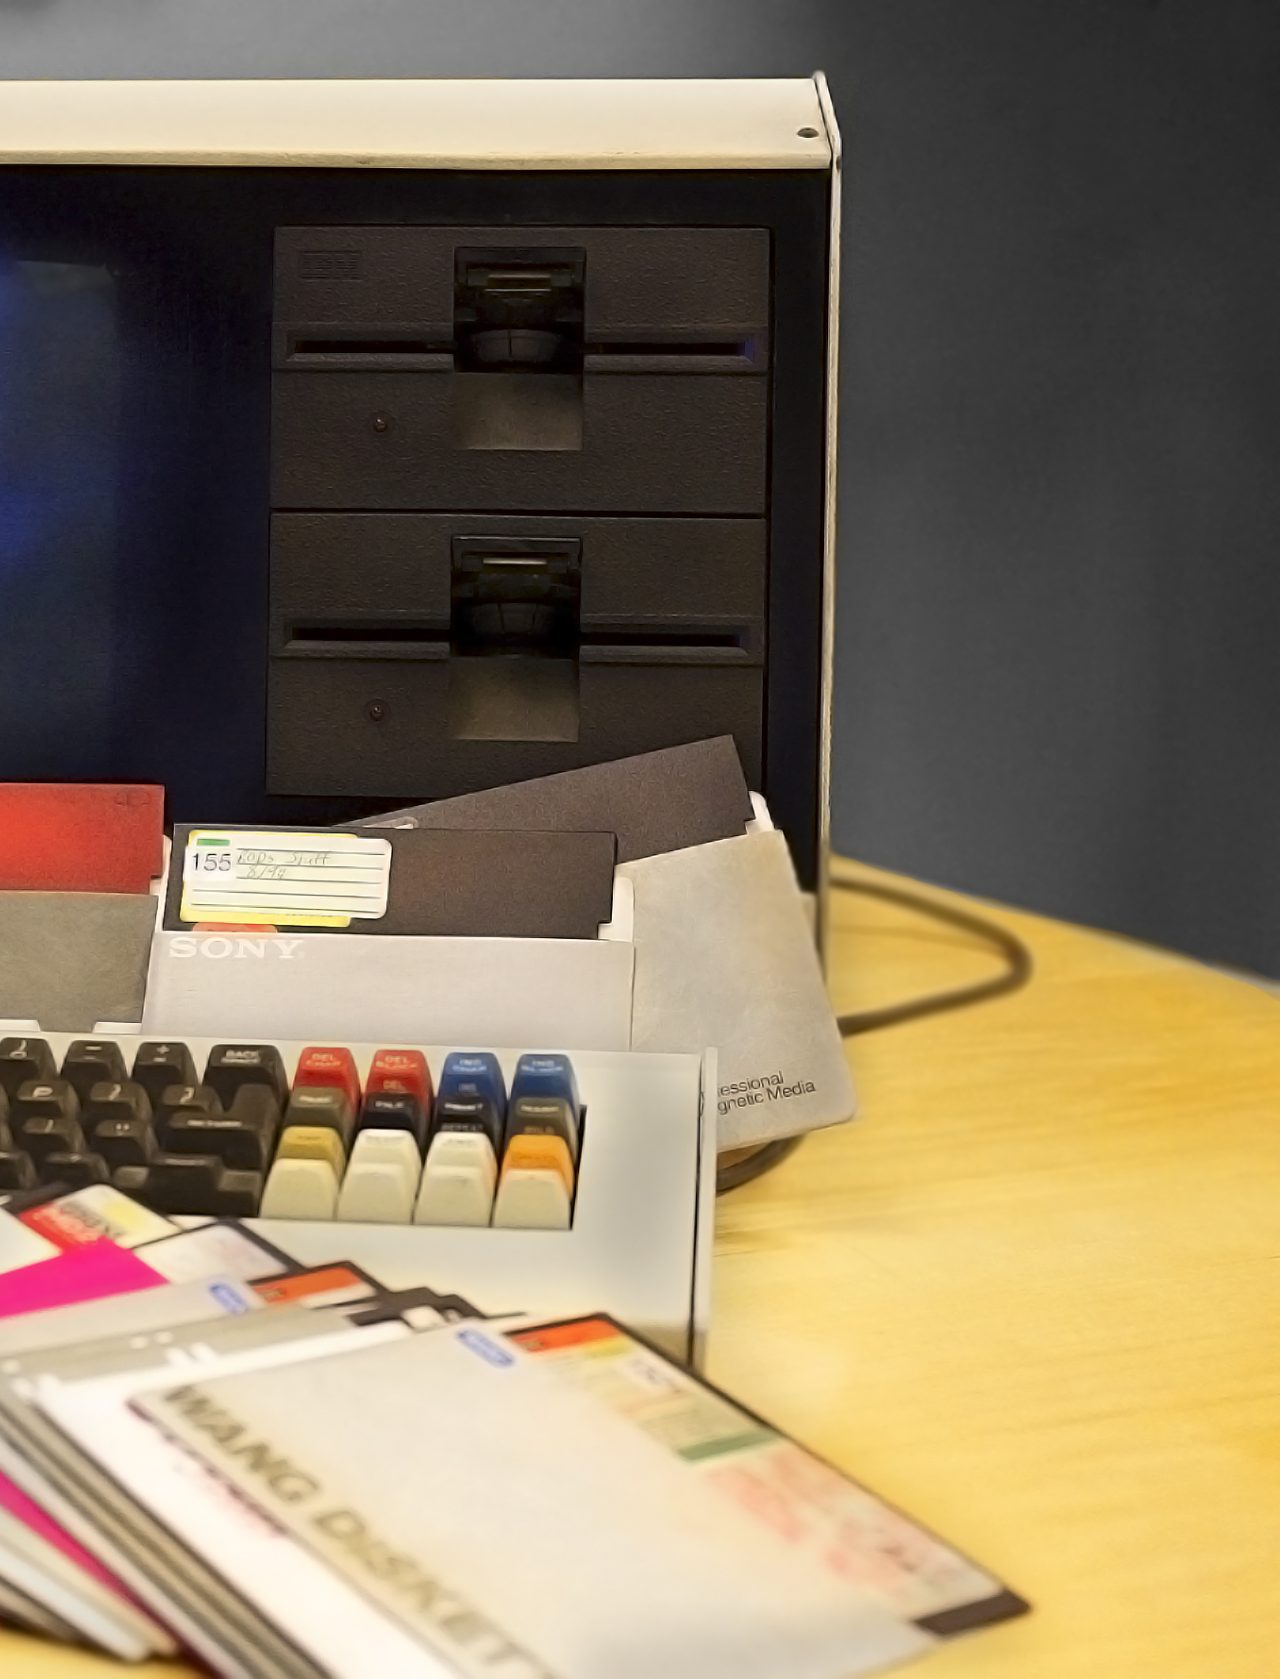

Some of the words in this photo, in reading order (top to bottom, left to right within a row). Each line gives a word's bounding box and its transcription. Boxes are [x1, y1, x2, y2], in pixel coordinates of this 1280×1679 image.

[192, 853, 232, 871] 155
[168, 936, 305, 959] SONY
[717, 1070, 784, 1097] essional
[766, 1080, 817, 1101] Media
[163, 1383, 322, 1505] WANG
